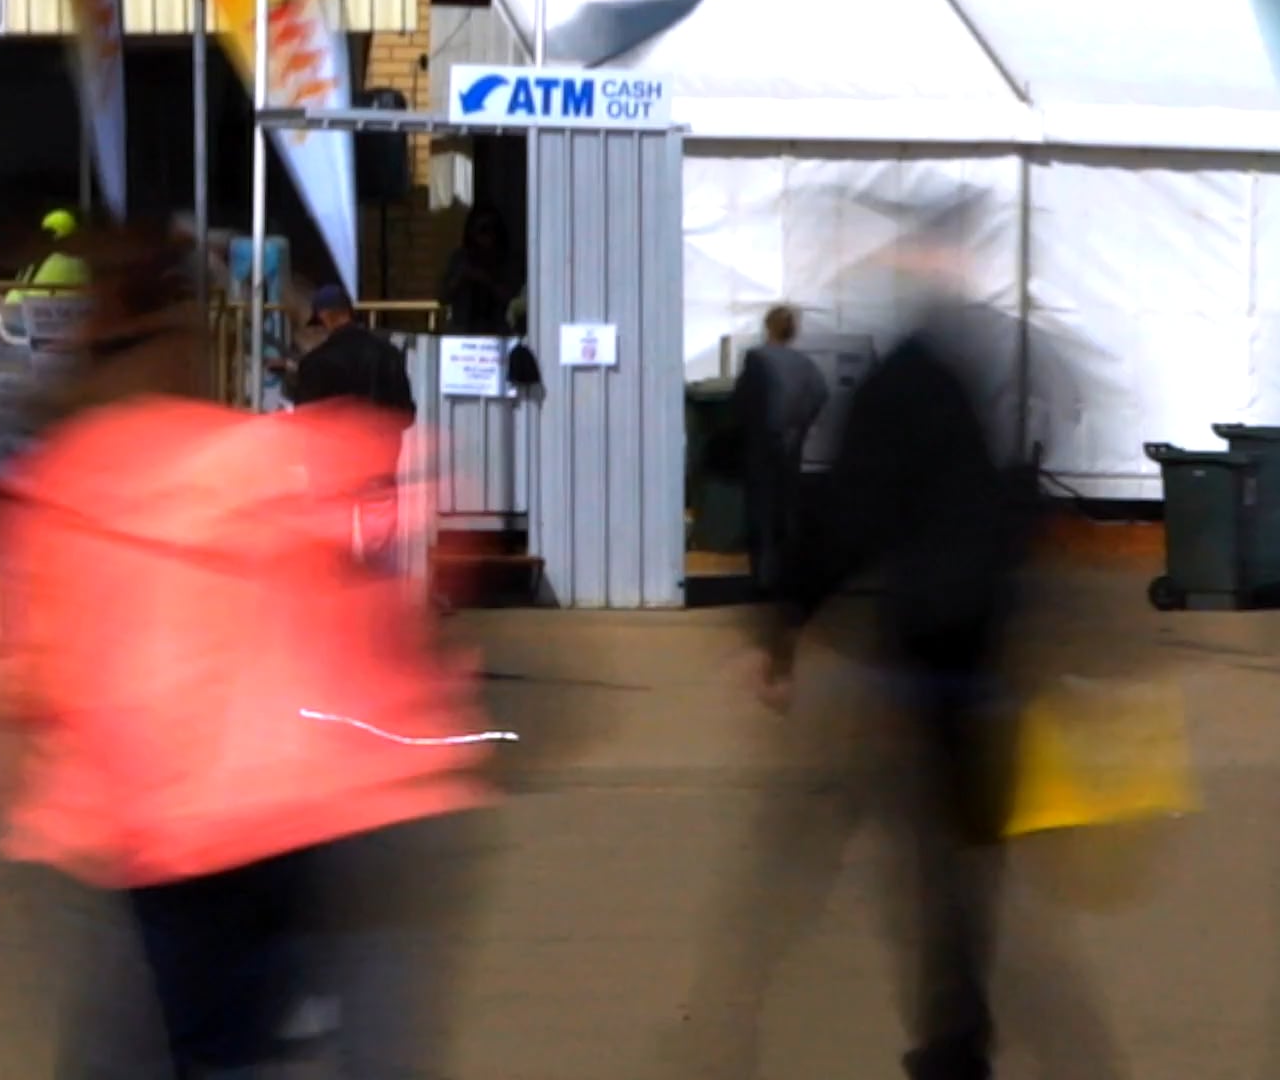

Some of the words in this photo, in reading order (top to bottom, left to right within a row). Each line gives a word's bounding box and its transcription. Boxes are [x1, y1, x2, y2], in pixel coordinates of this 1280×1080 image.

[507, 77, 594, 117] ATM
[601, 80, 663, 100] CASH
[607, 101, 653, 119] OUT
